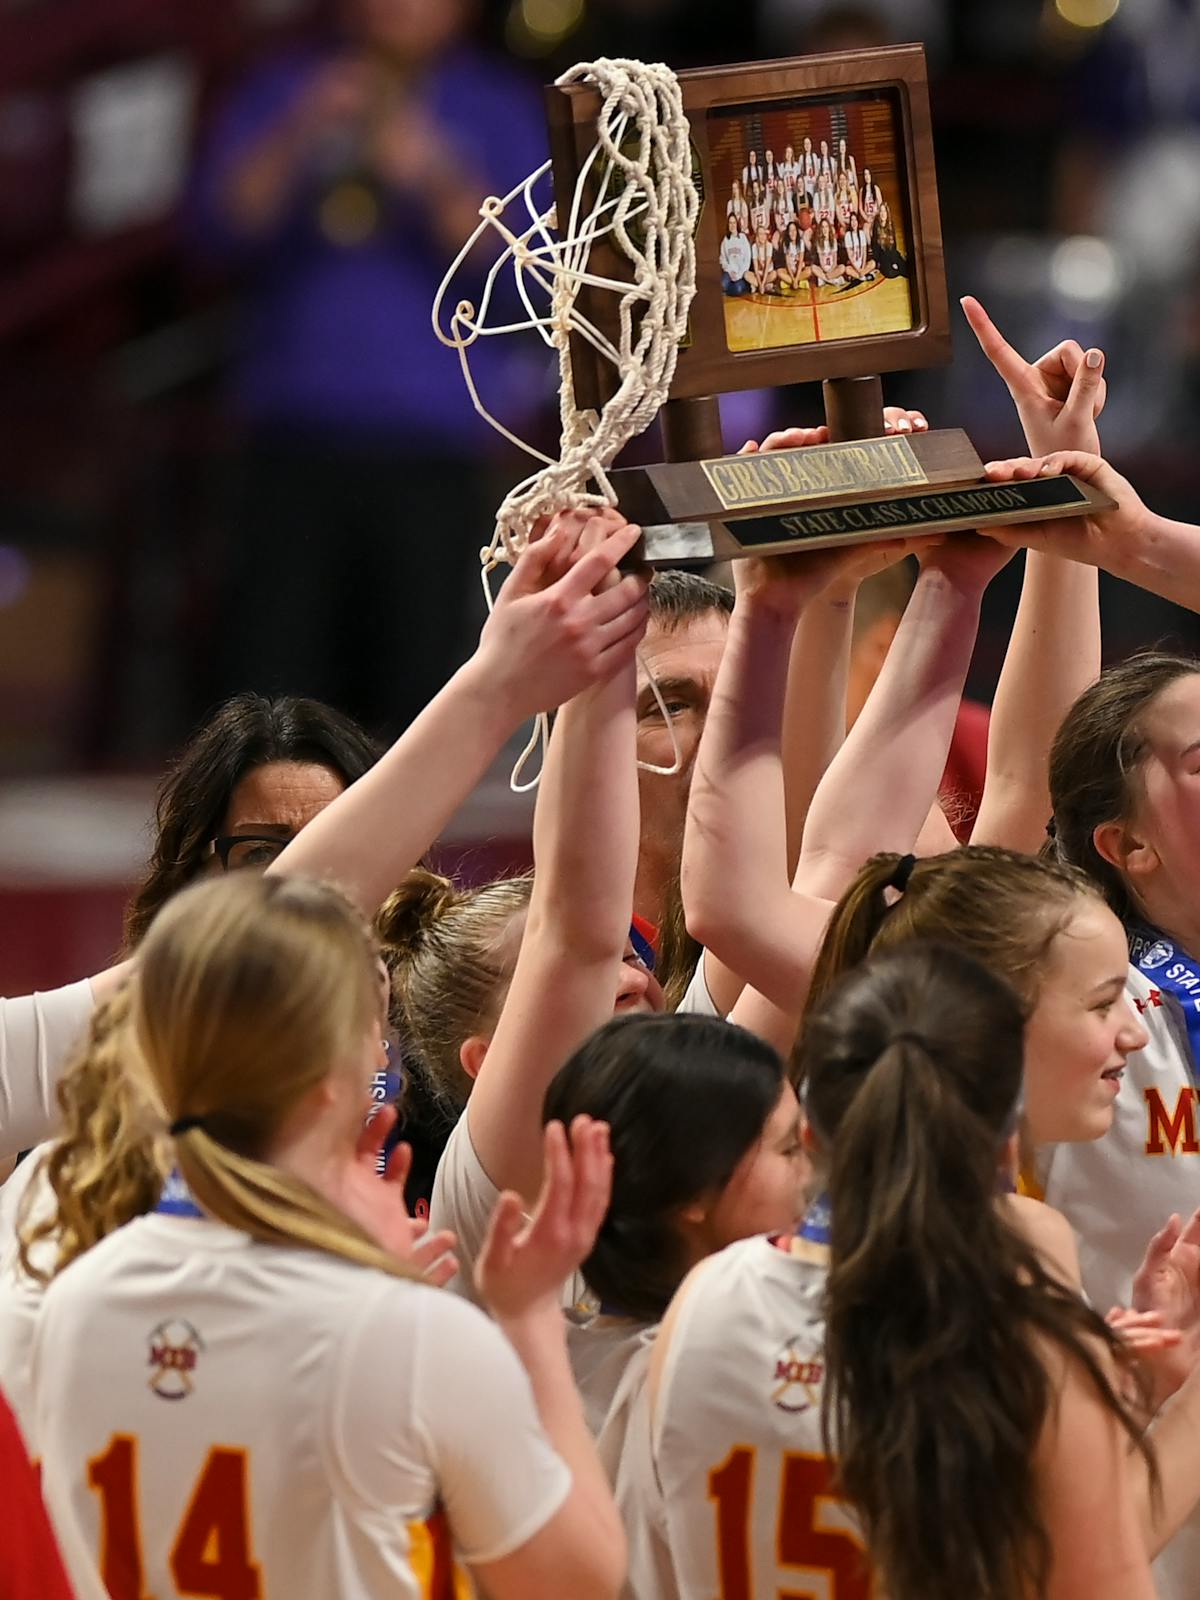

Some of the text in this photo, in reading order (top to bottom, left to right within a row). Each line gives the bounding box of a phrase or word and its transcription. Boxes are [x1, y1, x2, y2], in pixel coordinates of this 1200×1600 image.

[711, 441, 921, 501] GIRLS BASKETBALL
[780, 487, 1028, 536] STATE CLASS A CHAMPION
[87, 1433, 263, 1600] 14
[708, 1443, 874, 1600] 15
